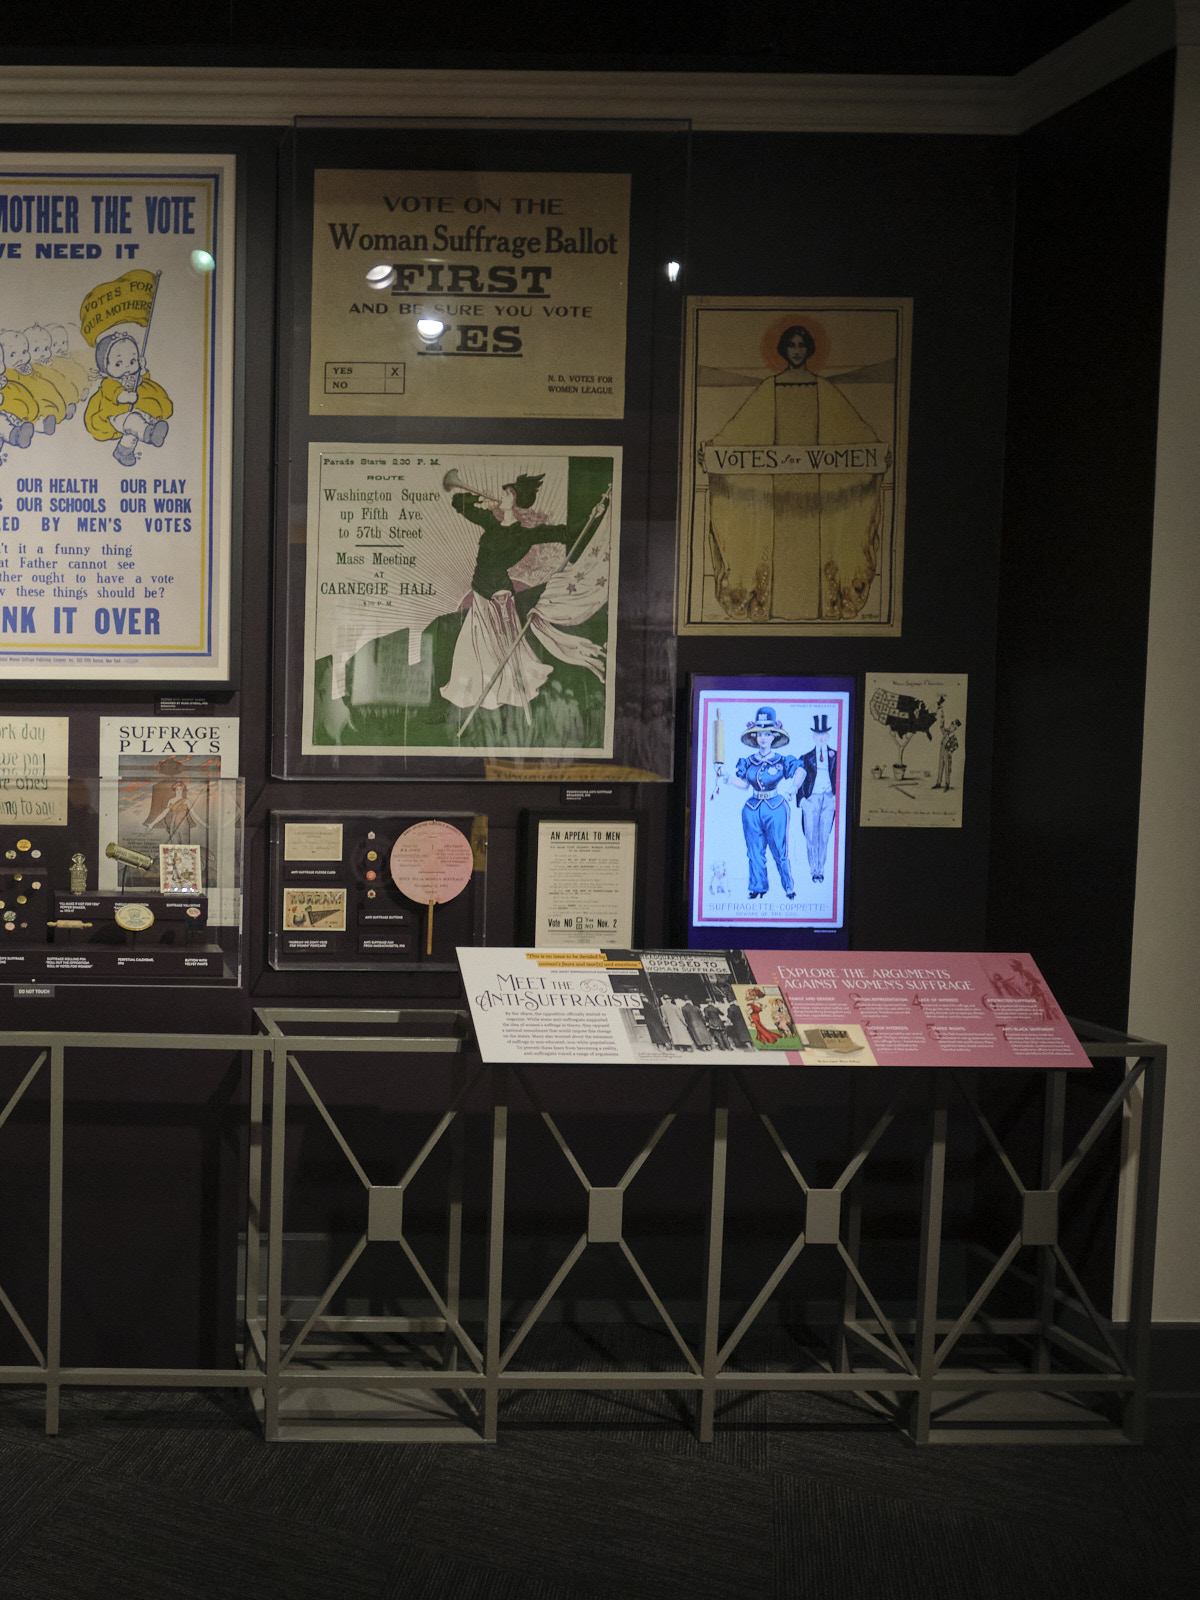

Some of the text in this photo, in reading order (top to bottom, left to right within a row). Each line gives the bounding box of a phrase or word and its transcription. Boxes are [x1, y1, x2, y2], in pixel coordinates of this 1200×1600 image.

[383, 196, 565, 216] VOTE ON THE
[91, 195, 132, 234] THE
[146, 196, 195, 235] VOTE
[328, 222, 618, 258] Woman Suffrage Ballot
[35, 243, 102, 260] NEED
[117, 244, 139, 259] IT
[391, 264, 552, 295] FIRST
[84, 281, 153, 313] VOTES FOR
[83, 300, 152, 334] OUR MOTHERS
[349, 303, 593, 318] AND BE SURE YOU VOTE
[333, 367, 353, 375] YES
[569, 375, 595, 383] VOTES
[332, 381, 348, 389] NO
[548, 385, 613, 394] WOMEN LEAGUE
[715, 448, 877, 469] VOTES for WOMEN
[17, 478, 43, 494] OUR
[49, 478, 98, 494] HEALTH
[121, 479, 147, 494] OUR
[154, 479, 186, 495] PLAY
[324, 488, 440, 504] Washington Square
[340, 507, 423, 521] up Fifth Ave.
[41, 517, 60, 532] BY
[77, 517, 122, 533] MEN'S
[145, 517, 192, 533] VOTES
[339, 525, 423, 540] to 57th Street
[18, 542, 27, 555] it
[37, 546, 44, 555] a
[55, 543, 91, 558] funny
[101, 544, 133, 558] thing
[20, 557, 58, 569] Father
[68, 558, 107, 570] cannot
[118, 561, 135, 570] see
[336, 552, 416, 568] Mass Meeting
[16, 585, 45, 598] these
[53, 586, 88, 600] things
[97, 587, 136, 599] should
[144, 587, 165, 599] be?
[320, 581, 437, 596] CARNEGIE HALL
[53, 606, 78, 635] IT
[94, 607, 160, 636] OVER
[22, 723, 46, 743] day
[120, 726, 220, 739] SUFFRAGE
[120, 740, 220, 753] PLAYS
[550, 832, 620, 841] AN APPEAL TO MEN
[777, 966, 950, 979] EXPLORE THE ARGUMENTS
[496, 974, 575, 991] MEET THE
[784, 979, 976, 991] AGAINST WOMEN'S SUFFRAGE
[475, 990, 641, 1012] ANTI-SUFFRAGISTS
